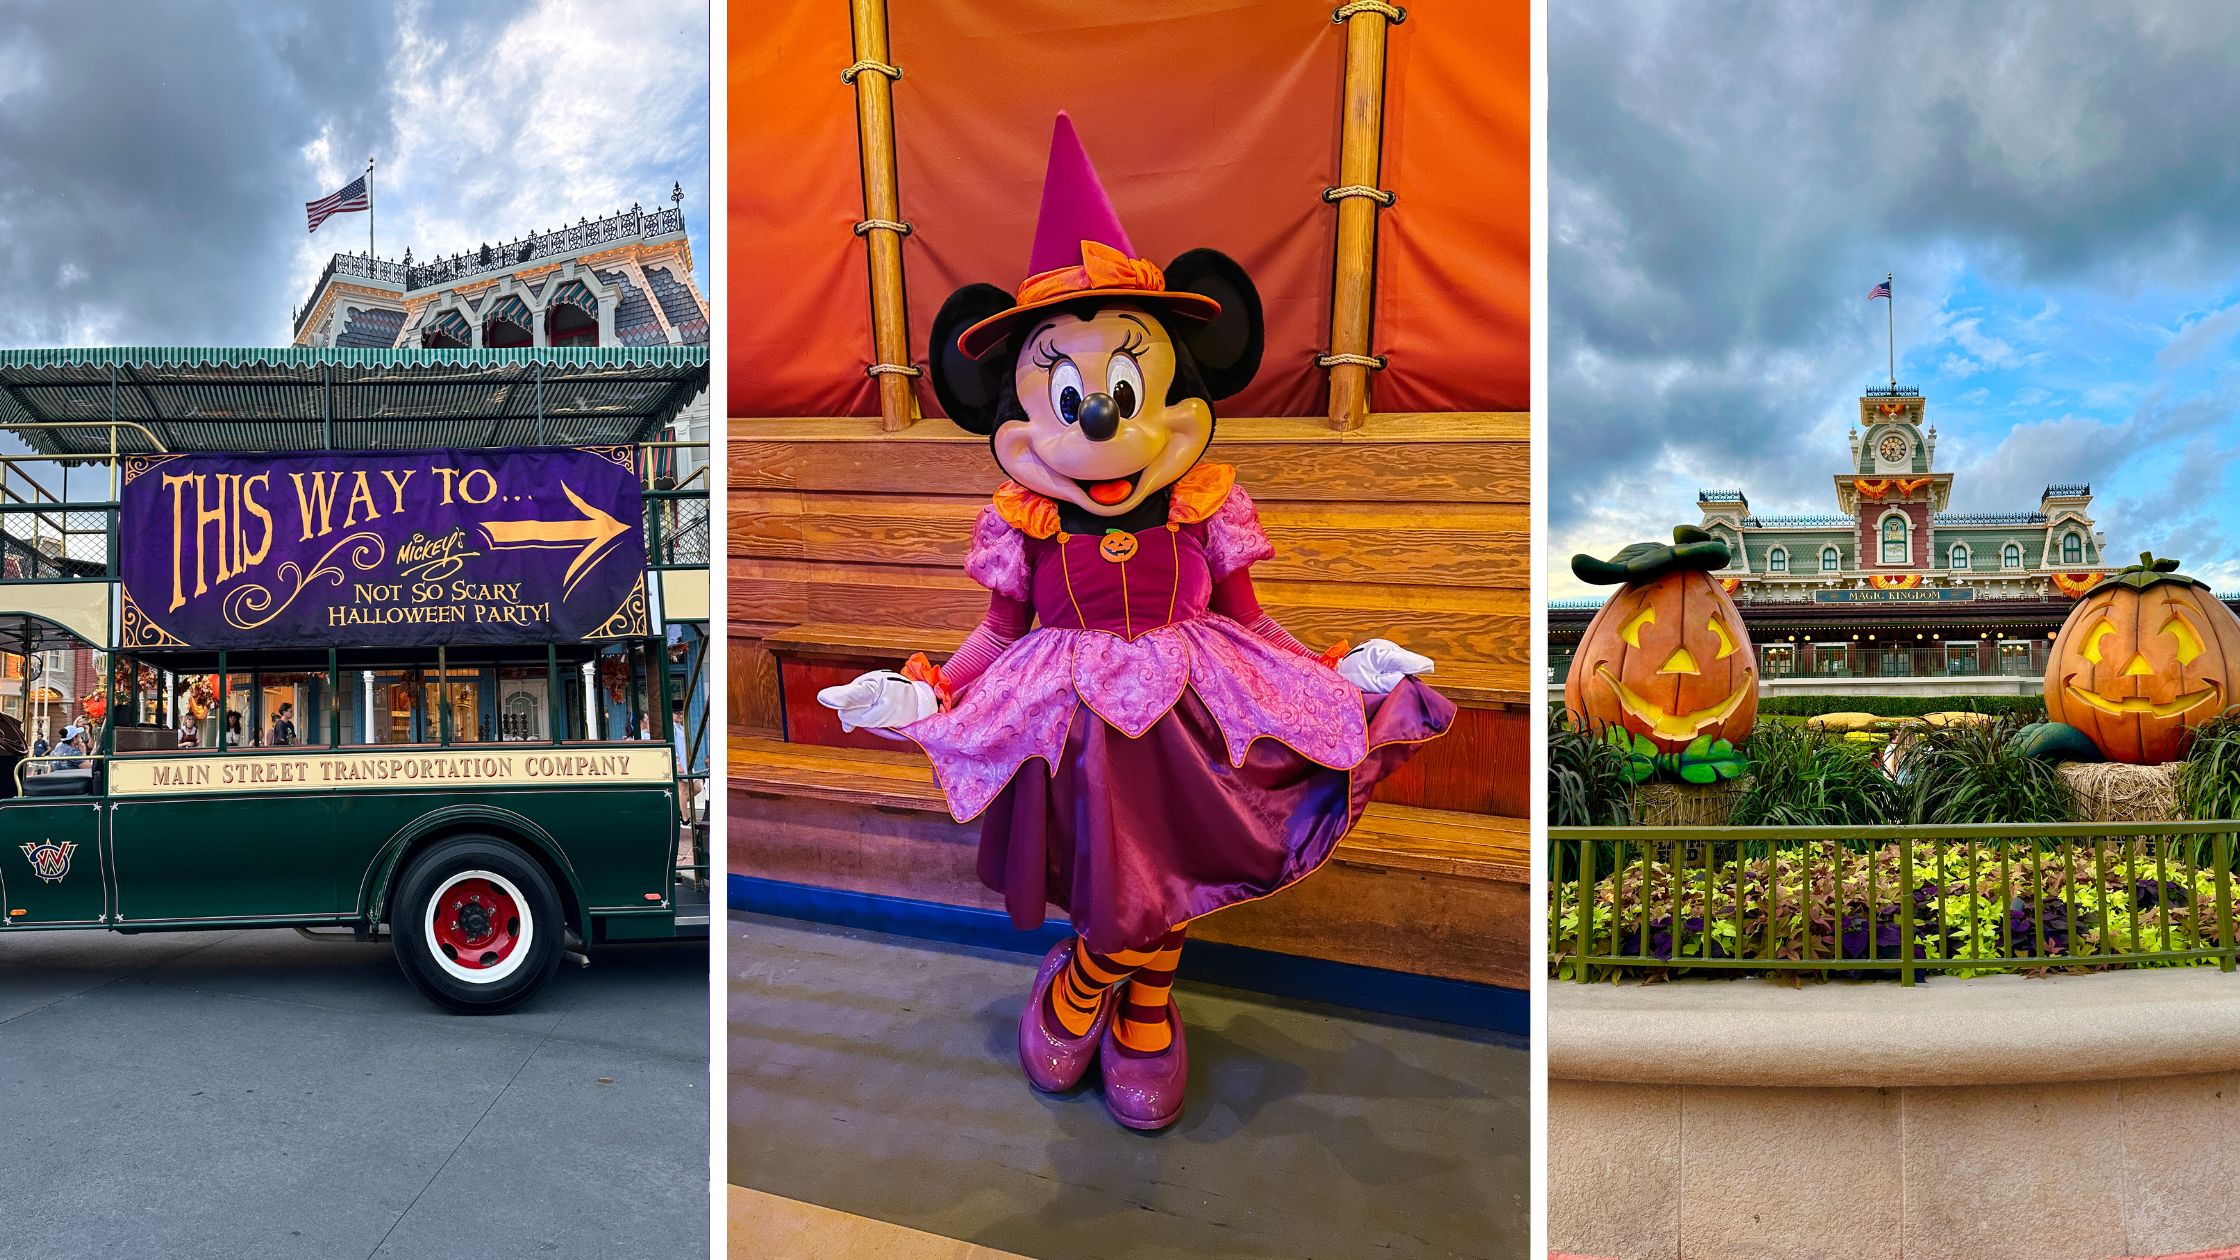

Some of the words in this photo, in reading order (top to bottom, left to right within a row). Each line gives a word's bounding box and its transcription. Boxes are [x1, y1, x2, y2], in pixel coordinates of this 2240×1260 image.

[162, 470, 273, 614] THIS
[289, 469, 416, 542] WAY
[431, 466, 533, 506] TO...
[354, 583, 402, 605] NOT
[411, 581, 444, 604] SO
[451, 579, 522, 605] SCARY
[1849, 591, 1885, 601] MAGIC
[1888, 590, 1941, 600] KINGDOM
[328, 604, 466, 627] HALLOWEEN
[474, 602, 550, 627] PARTY!
[152, 764, 210, 786] MAIN
[222, 761, 309, 784] STREET
[320, 757, 513, 782] TRANSPORTATION
[524, 755, 630, 777] COMPANY
